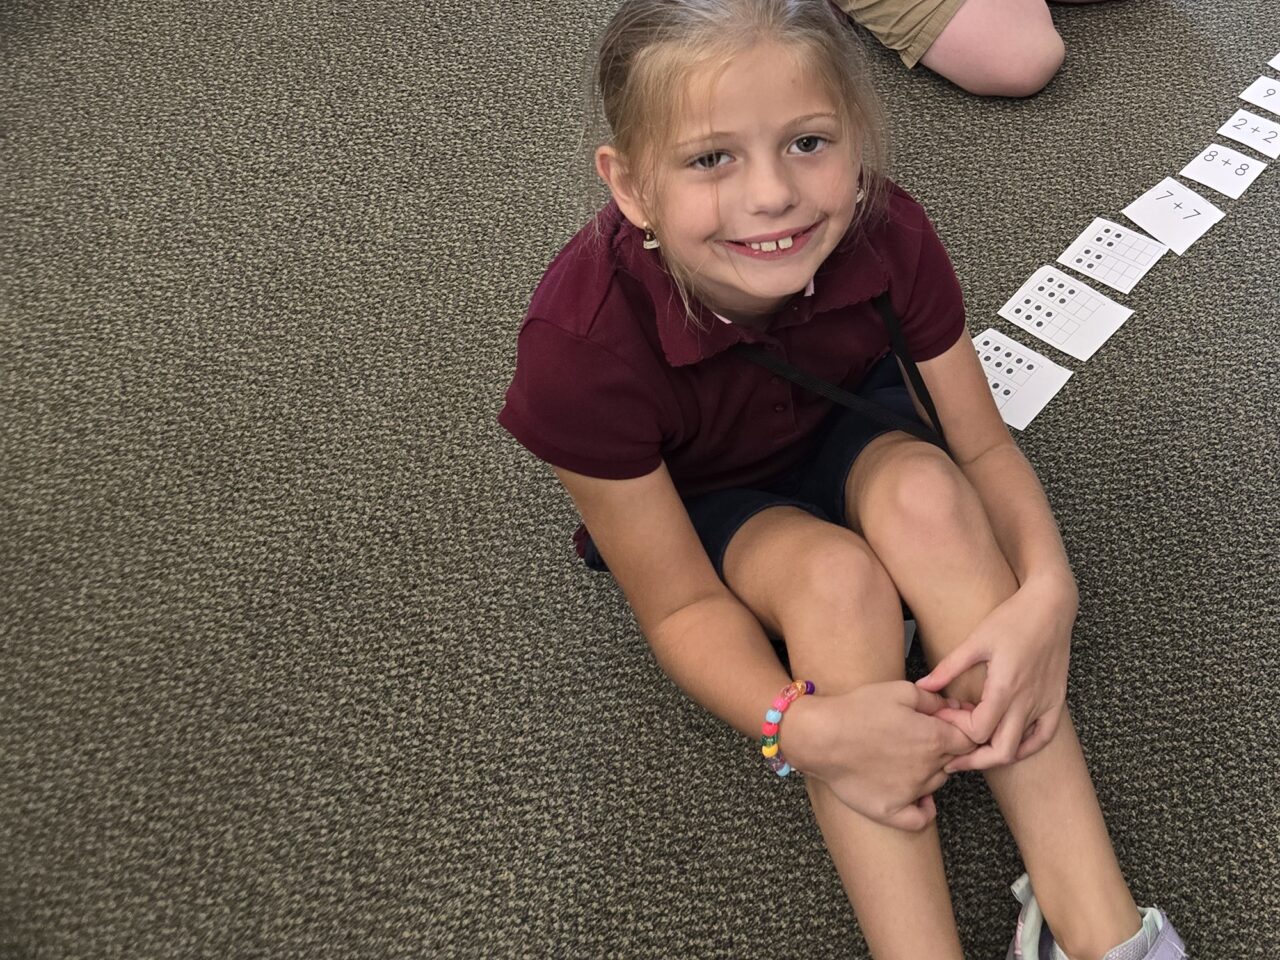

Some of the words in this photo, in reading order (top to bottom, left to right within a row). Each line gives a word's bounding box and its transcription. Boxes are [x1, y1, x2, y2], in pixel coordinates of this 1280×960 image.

[1263, 88, 1277, 98] 9
[1232, 117, 1248, 130] 2
[1261, 130, 1279, 144] 2
[1202, 149, 1220, 163] 8
[1234, 163, 1250, 177] 8
[1155, 190, 1175, 201] 7
[1182, 208, 1202, 220] 7
